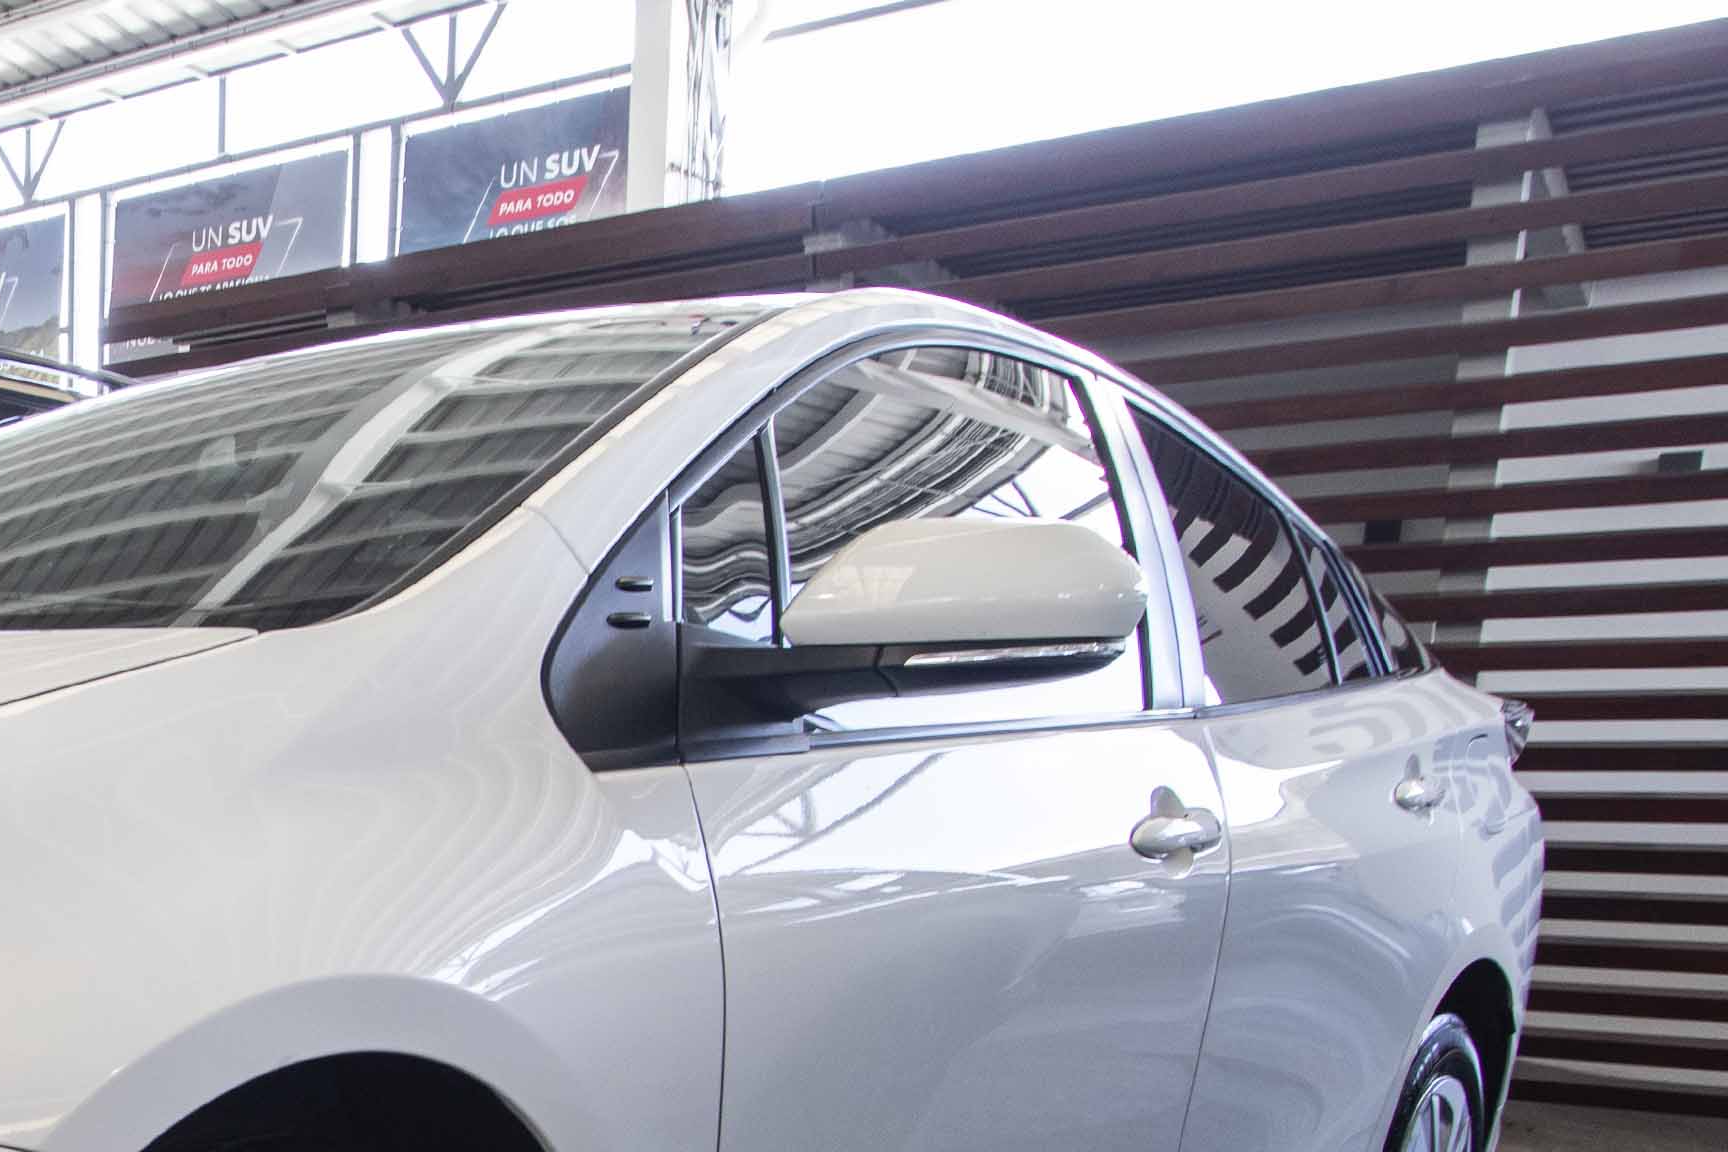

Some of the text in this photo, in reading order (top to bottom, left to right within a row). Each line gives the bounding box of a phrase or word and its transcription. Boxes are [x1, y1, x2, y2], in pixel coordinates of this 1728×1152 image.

[500, 144, 601, 188] UN SUV
[498, 190, 575, 216] PARA TODO
[191, 214, 274, 252] UN SUV
[191, 254, 253, 277] PARA TODO
